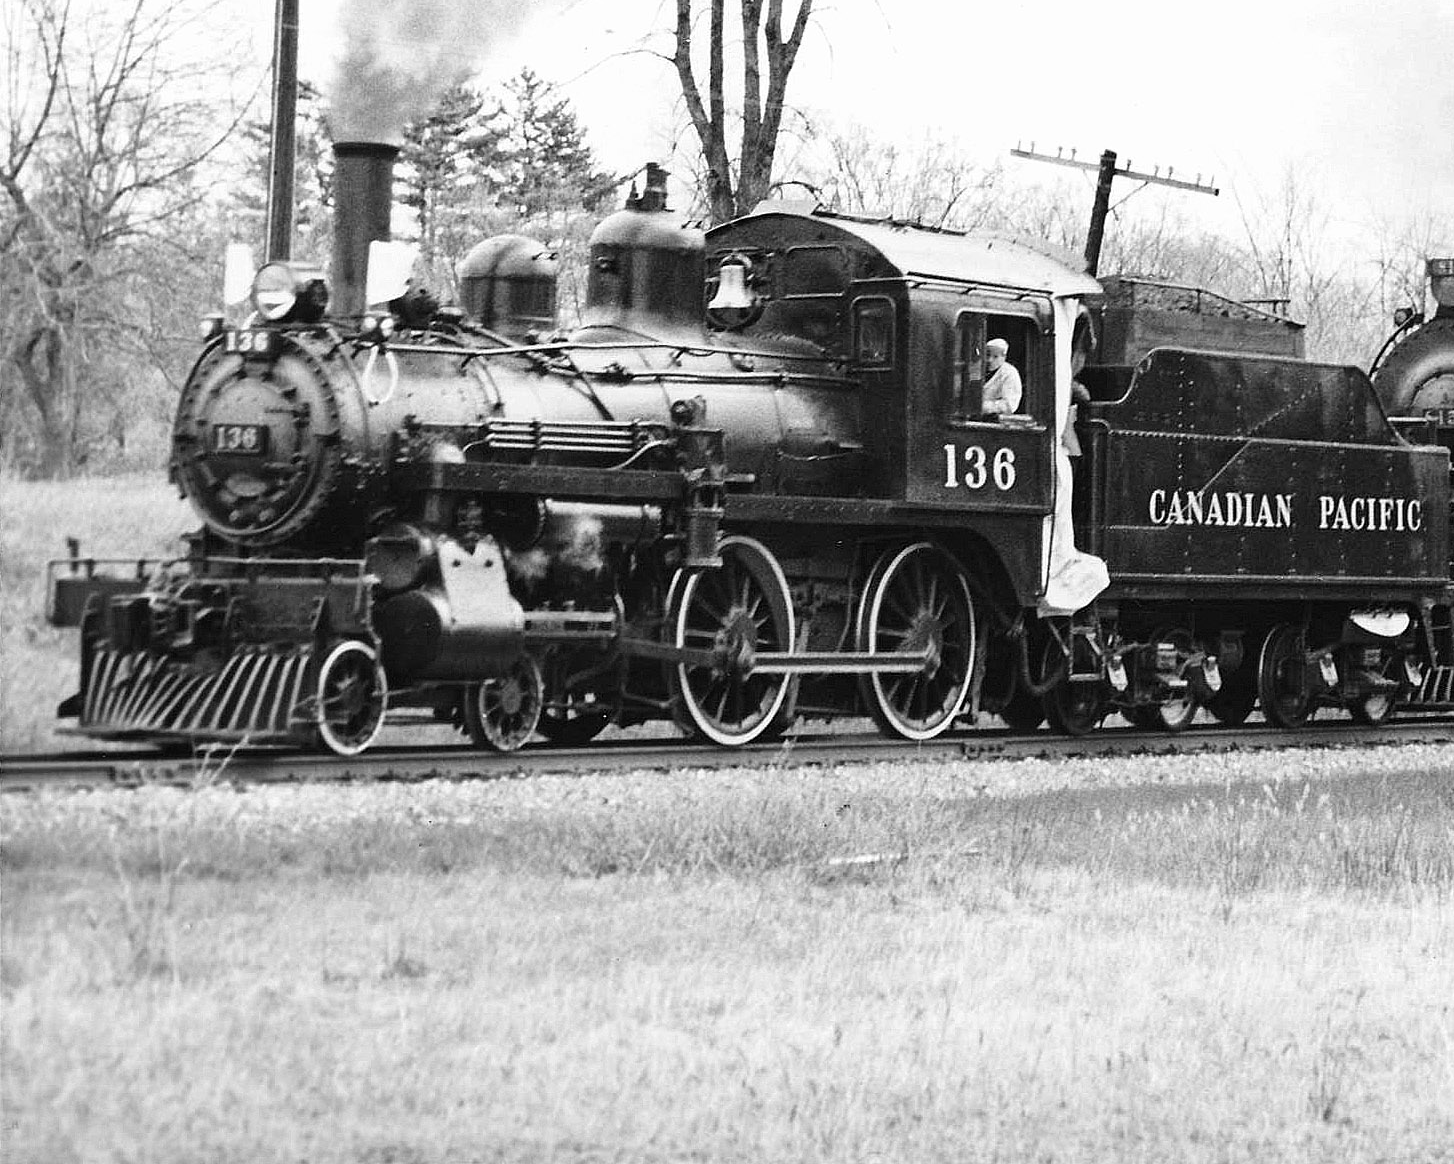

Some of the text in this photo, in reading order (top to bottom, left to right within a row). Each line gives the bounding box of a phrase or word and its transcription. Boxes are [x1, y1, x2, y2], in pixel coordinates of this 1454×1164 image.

[226, 331, 268, 352] 136
[217, 426, 257, 449] 136
[943, 443, 1016, 491] 136
[1149, 489, 1421, 531] CANADIAN PACIFIC
